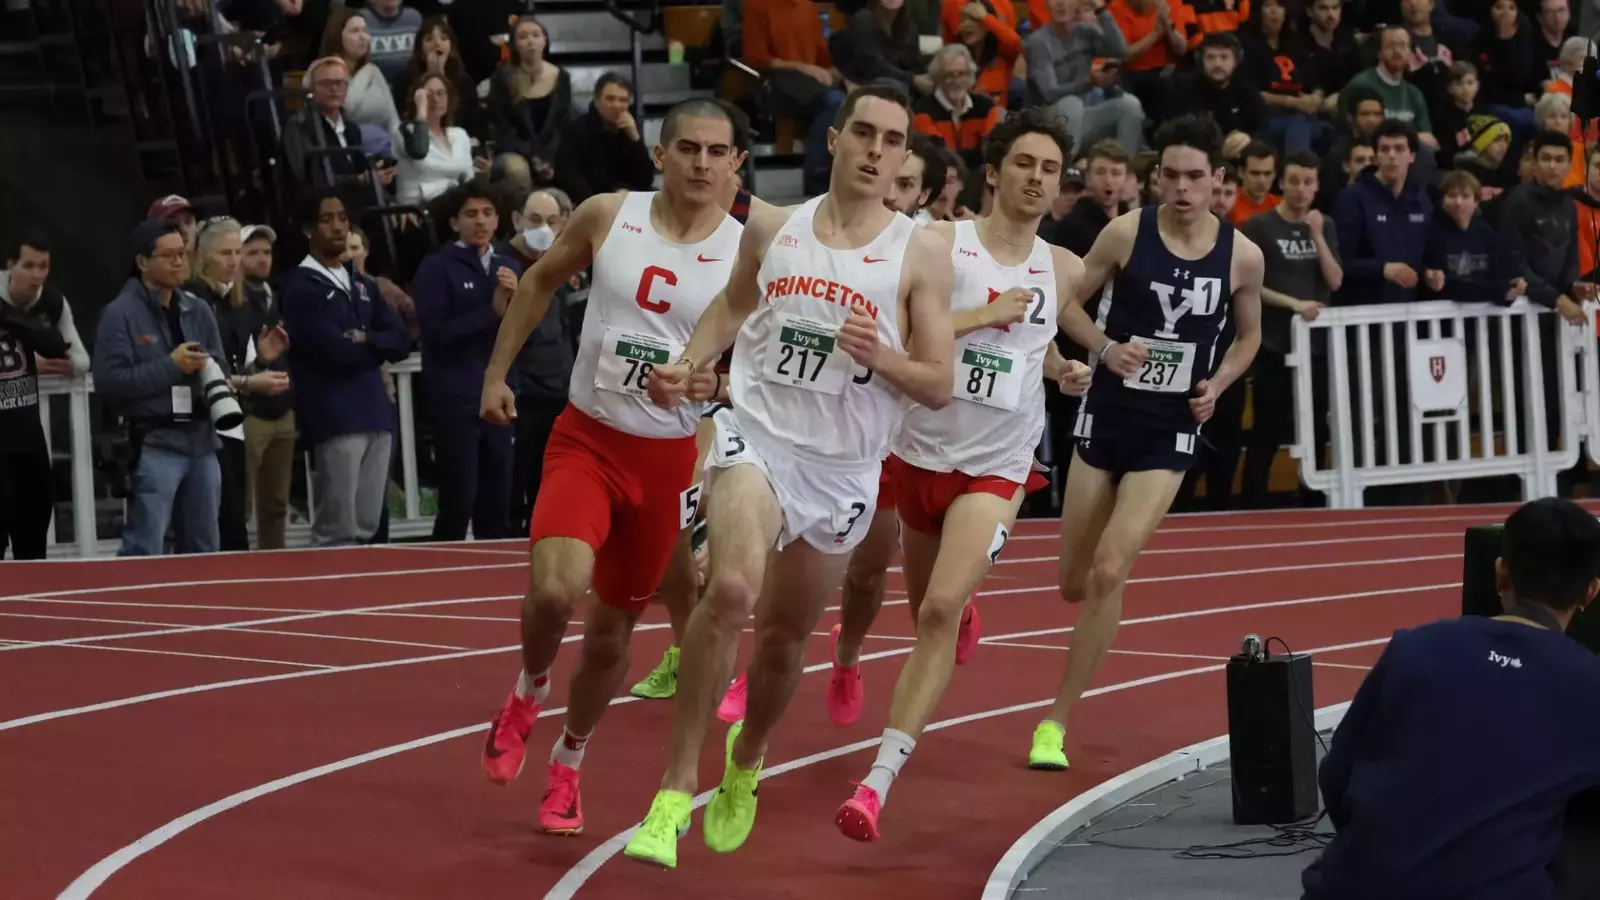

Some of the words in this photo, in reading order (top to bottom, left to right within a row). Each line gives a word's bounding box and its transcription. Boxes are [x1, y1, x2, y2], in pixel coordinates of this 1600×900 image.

[622, 222, 635, 233] Ivy
[959, 248, 972, 257] Ivy
[635, 265, 678, 314] C
[765, 276, 879, 320] PRINCETON
[1201, 281, 1213, 313] 1
[1029, 287, 1046, 325] 2
[1150, 281, 1194, 339] Y
[629, 346, 647, 359] Ivy
[793, 331, 811, 346] Ivy
[777, 344, 828, 382] 217
[976, 354, 991, 367] Ivy
[1151, 350, 1166, 361] Ivy
[623, 359, 654, 389] 78
[967, 367, 997, 398] 81
[1139, 361, 1178, 386] 237
[686, 486, 699, 524] 5
[836, 502, 866, 537] 3
[1488, 650, 1511, 668] Ivy
